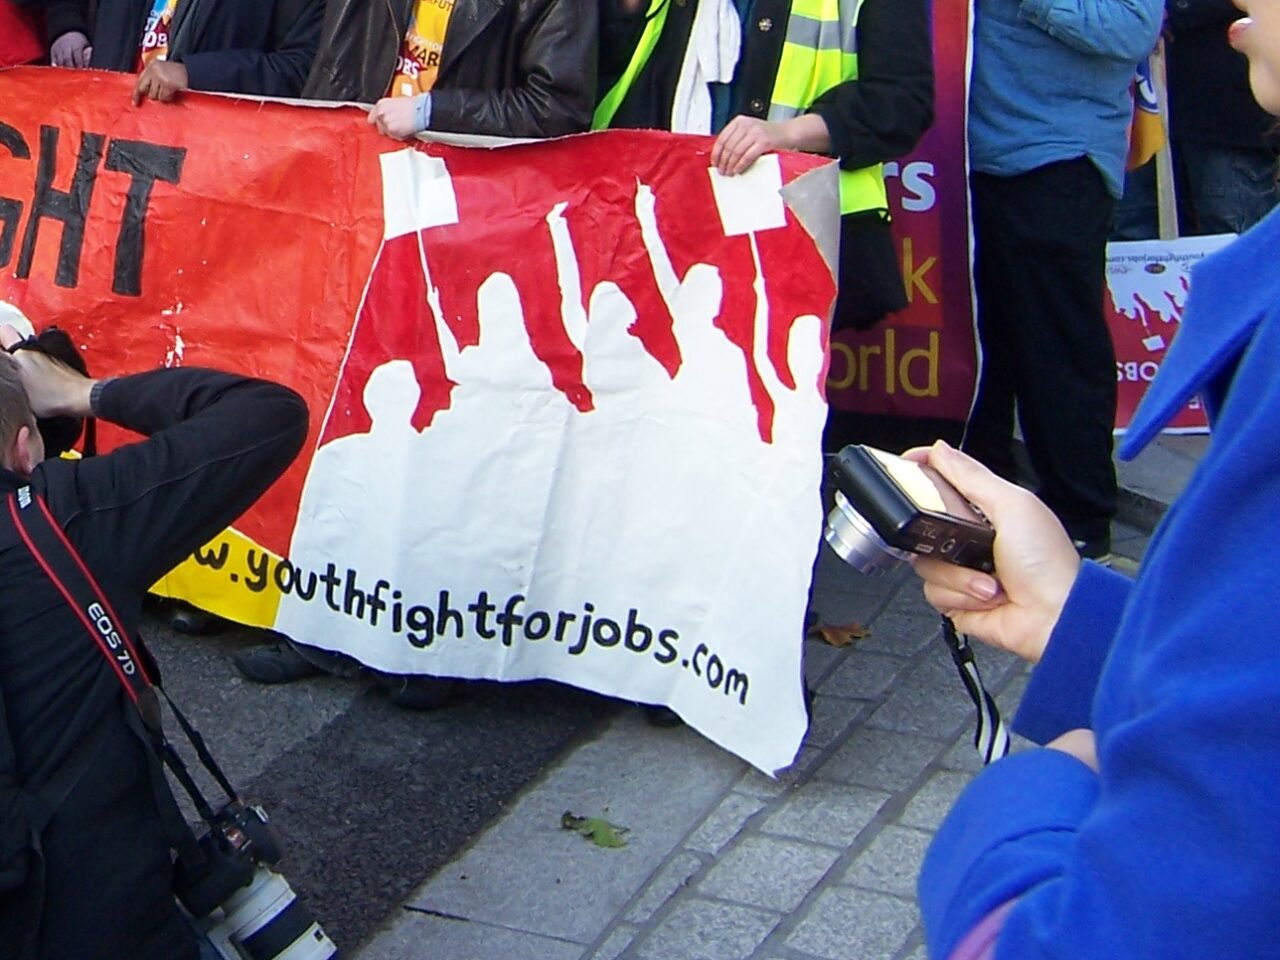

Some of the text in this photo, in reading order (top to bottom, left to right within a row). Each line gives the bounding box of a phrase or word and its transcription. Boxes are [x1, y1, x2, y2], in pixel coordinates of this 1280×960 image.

[826, 328, 940, 397] orld
[88, 602, 135, 675] EOS 7D
[186, 540, 750, 706] w.youthfightforjobs.com
